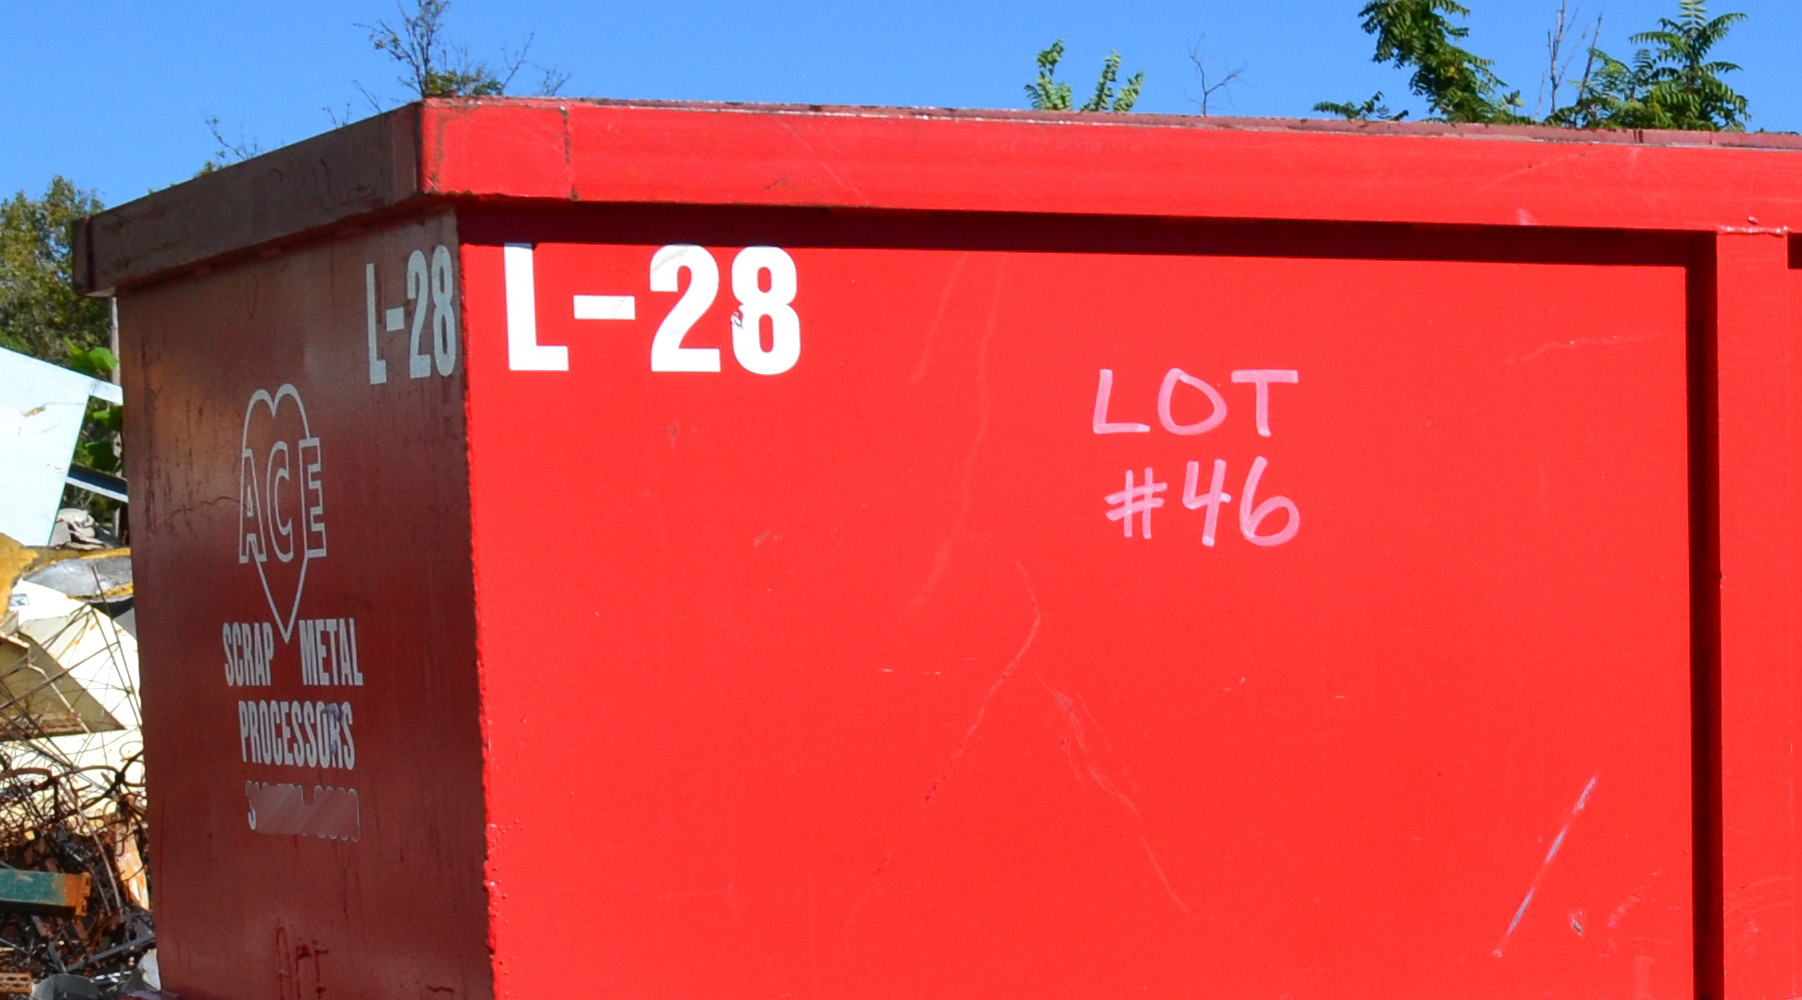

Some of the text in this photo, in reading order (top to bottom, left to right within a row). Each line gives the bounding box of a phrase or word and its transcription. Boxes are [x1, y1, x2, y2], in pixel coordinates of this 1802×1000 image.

[366, 245, 456, 385] L-28
[504, 244, 800, 375] L-28
[1093, 367, 1298, 437] LOT
[239, 437, 327, 565] ACE
[1104, 455, 1300, 548] #46
[222, 618, 364, 687] SCRAP METAL
[238, 700, 356, 771] PROCESSORS
